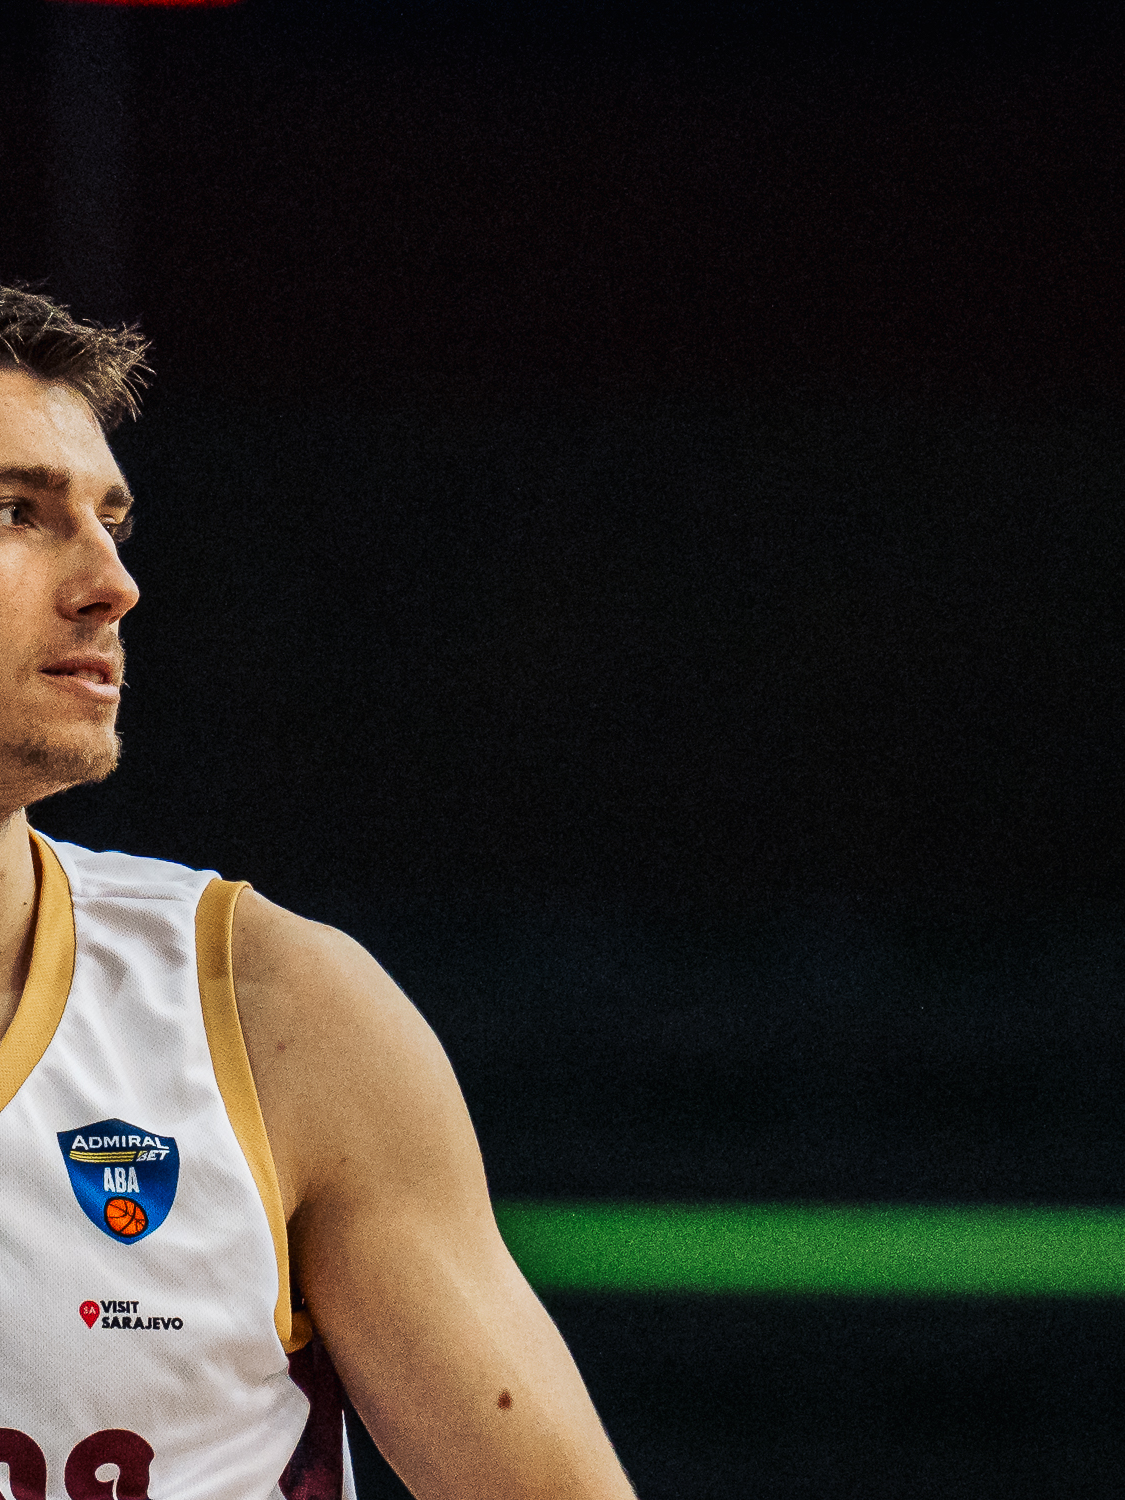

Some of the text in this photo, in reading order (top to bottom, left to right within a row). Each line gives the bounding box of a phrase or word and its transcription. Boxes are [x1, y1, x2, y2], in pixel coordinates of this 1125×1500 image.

[71, 1134, 170, 1151] ADMIRAL
[135, 1150, 170, 1162] BET
[103, 1166, 140, 1194] ABA
[100, 1300, 140, 1314] VISIT
[101, 1316, 184, 1331] SARAJEVO
